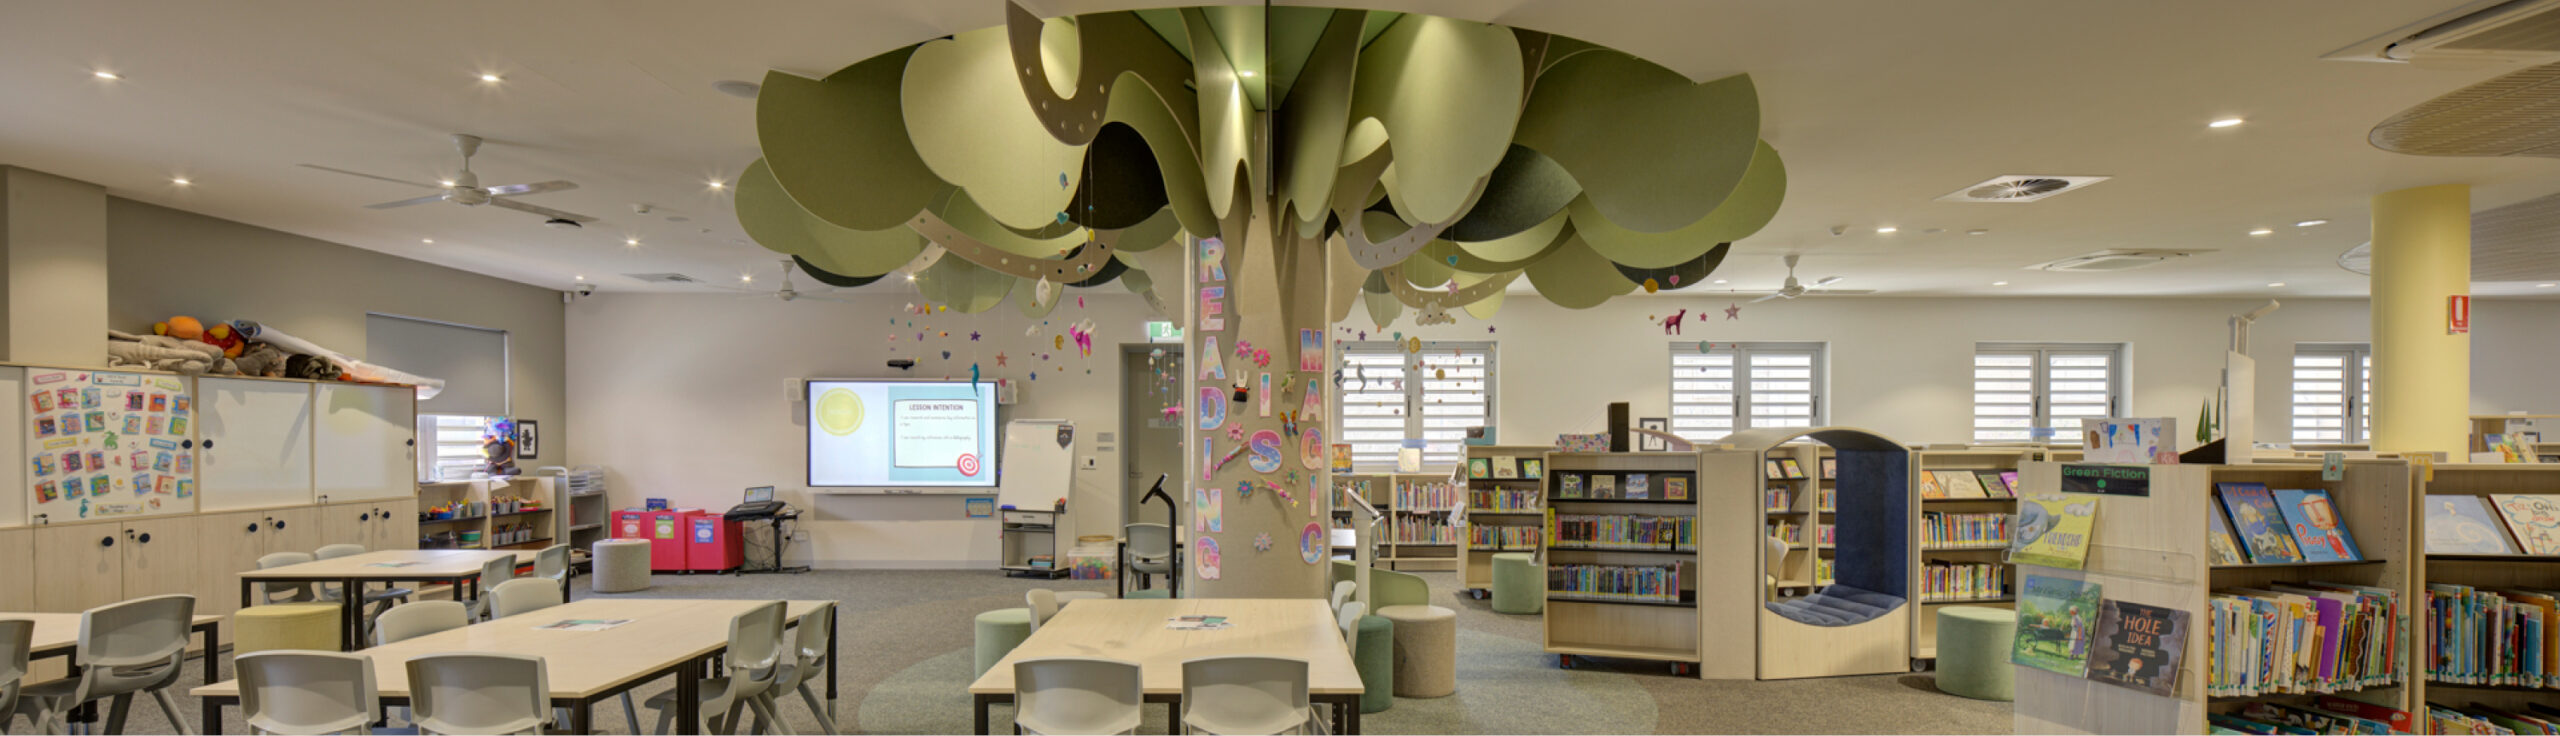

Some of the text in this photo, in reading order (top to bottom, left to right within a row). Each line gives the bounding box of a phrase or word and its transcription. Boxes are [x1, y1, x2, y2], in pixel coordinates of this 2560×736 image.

[1195, 237, 1227, 580] READING
[1248, 372, 1283, 474] IS
[1300, 328, 1324, 566] MAGIC
[2063, 466, 2146, 479] Green Fiction
[2124, 615, 2162, 636] HOLE
[2127, 632, 2152, 647] IDEA
